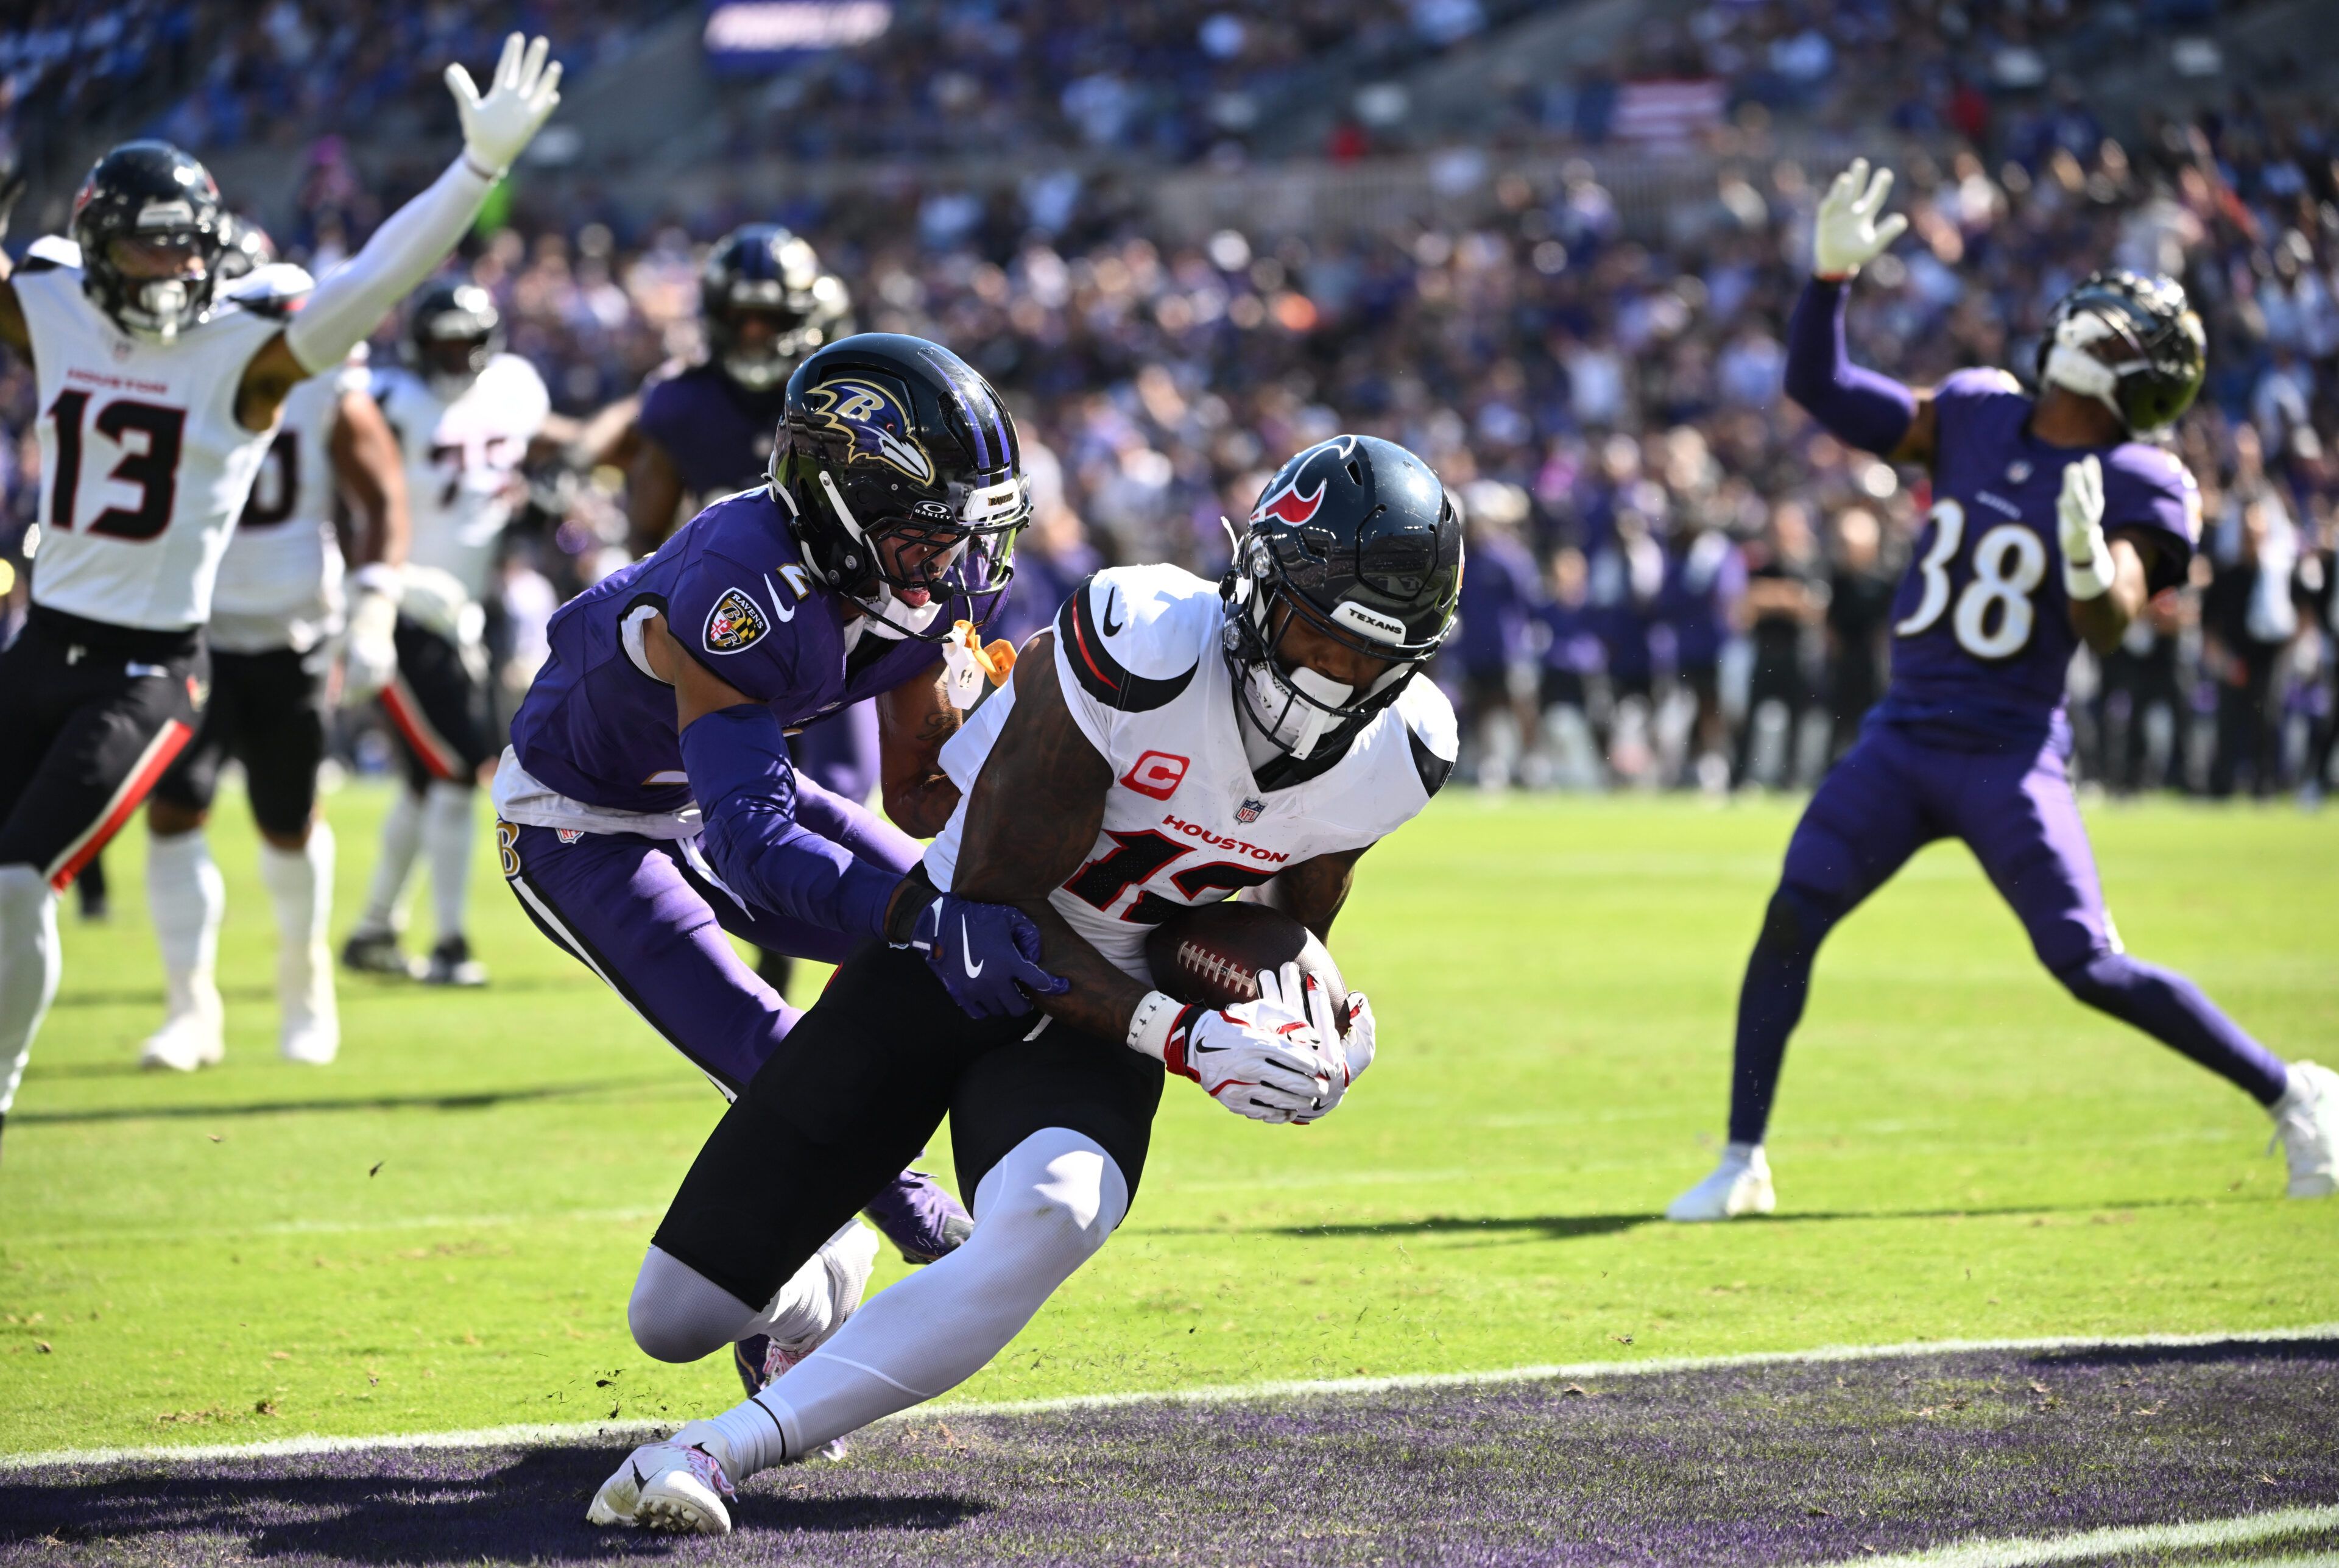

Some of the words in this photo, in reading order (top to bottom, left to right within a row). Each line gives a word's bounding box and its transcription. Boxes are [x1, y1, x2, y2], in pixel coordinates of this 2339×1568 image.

[834, 386, 885, 422] B
[47, 387, 186, 543] 13
[915, 509, 951, 520] OAKLEY
[987, 492, 1014, 506] RAVENS
[1894, 497, 2047, 660] 38
[721, 601, 744, 623] B
[732, 593, 764, 629] RAVENS
[1349, 609, 1402, 634] TEXANS
[1134, 755, 1183, 789] C
[1238, 808, 1257, 821] NFL
[496, 820, 520, 877] B
[1162, 814, 1289, 863] HOUSTON
